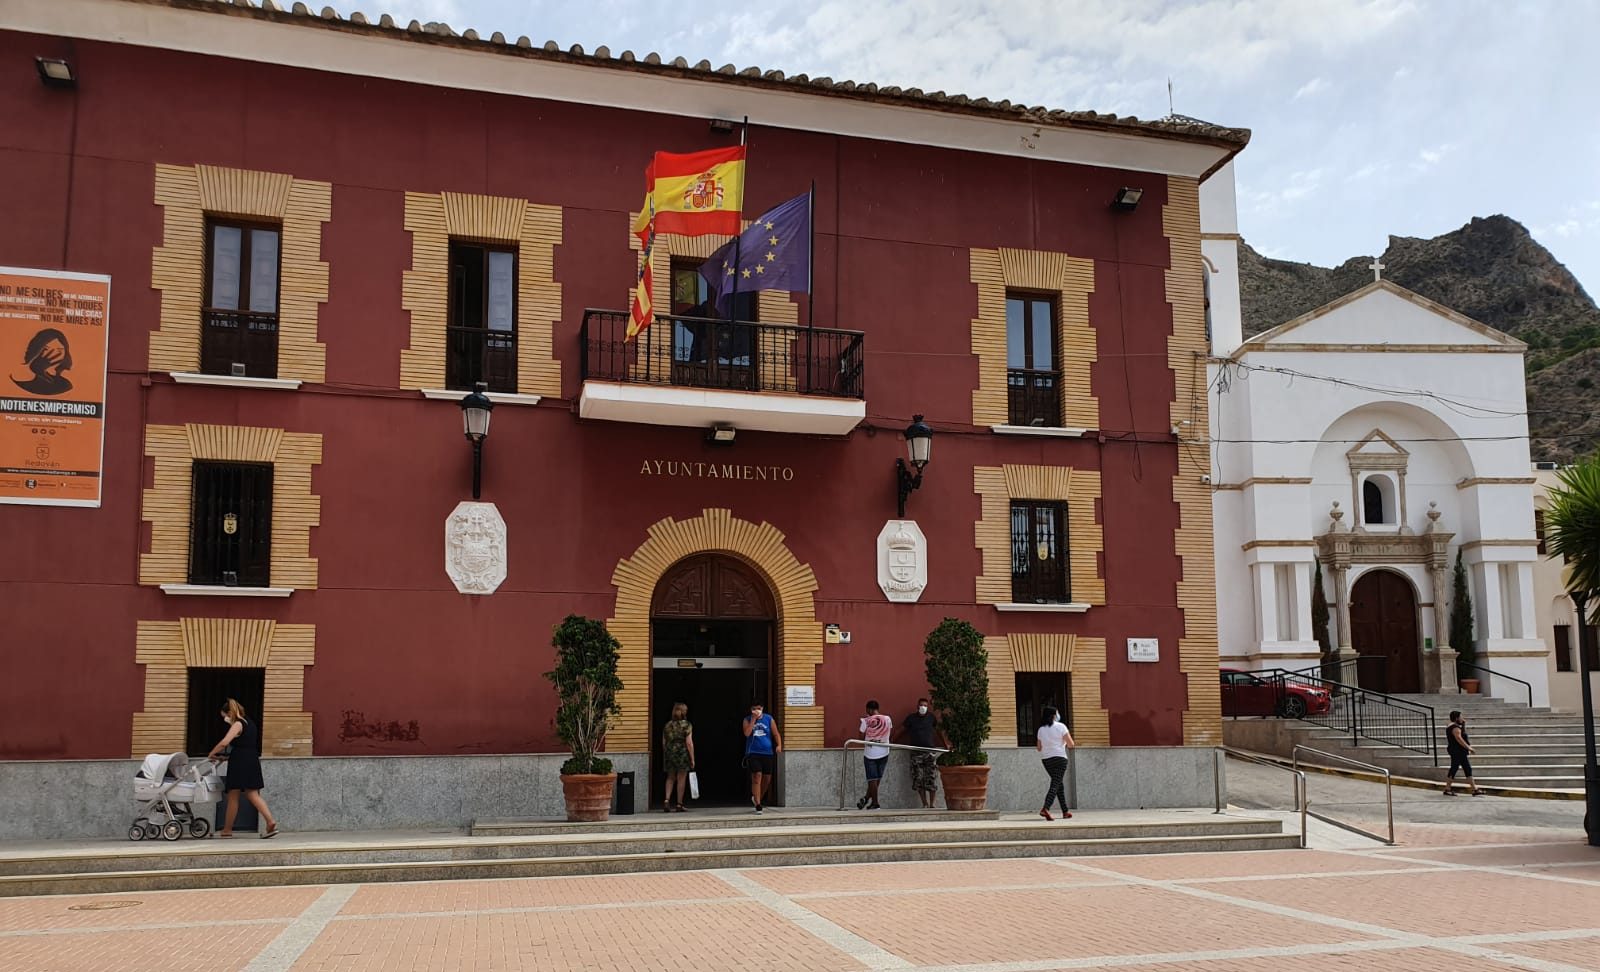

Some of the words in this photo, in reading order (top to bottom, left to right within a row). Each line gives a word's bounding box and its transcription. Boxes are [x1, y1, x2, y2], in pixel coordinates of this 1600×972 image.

[0, 286, 11, 295] NO
[16, 287, 30, 296] ME
[46, 299, 57, 308] NO
[58, 300, 71, 309] ME
[74, 300, 103, 311] TOQUES
[41, 314, 52, 323] NO
[53, 315, 65, 324] ME
[66, 316, 89, 325] MIRES
[640, 460, 794, 481] AYUNTAMIENTO
